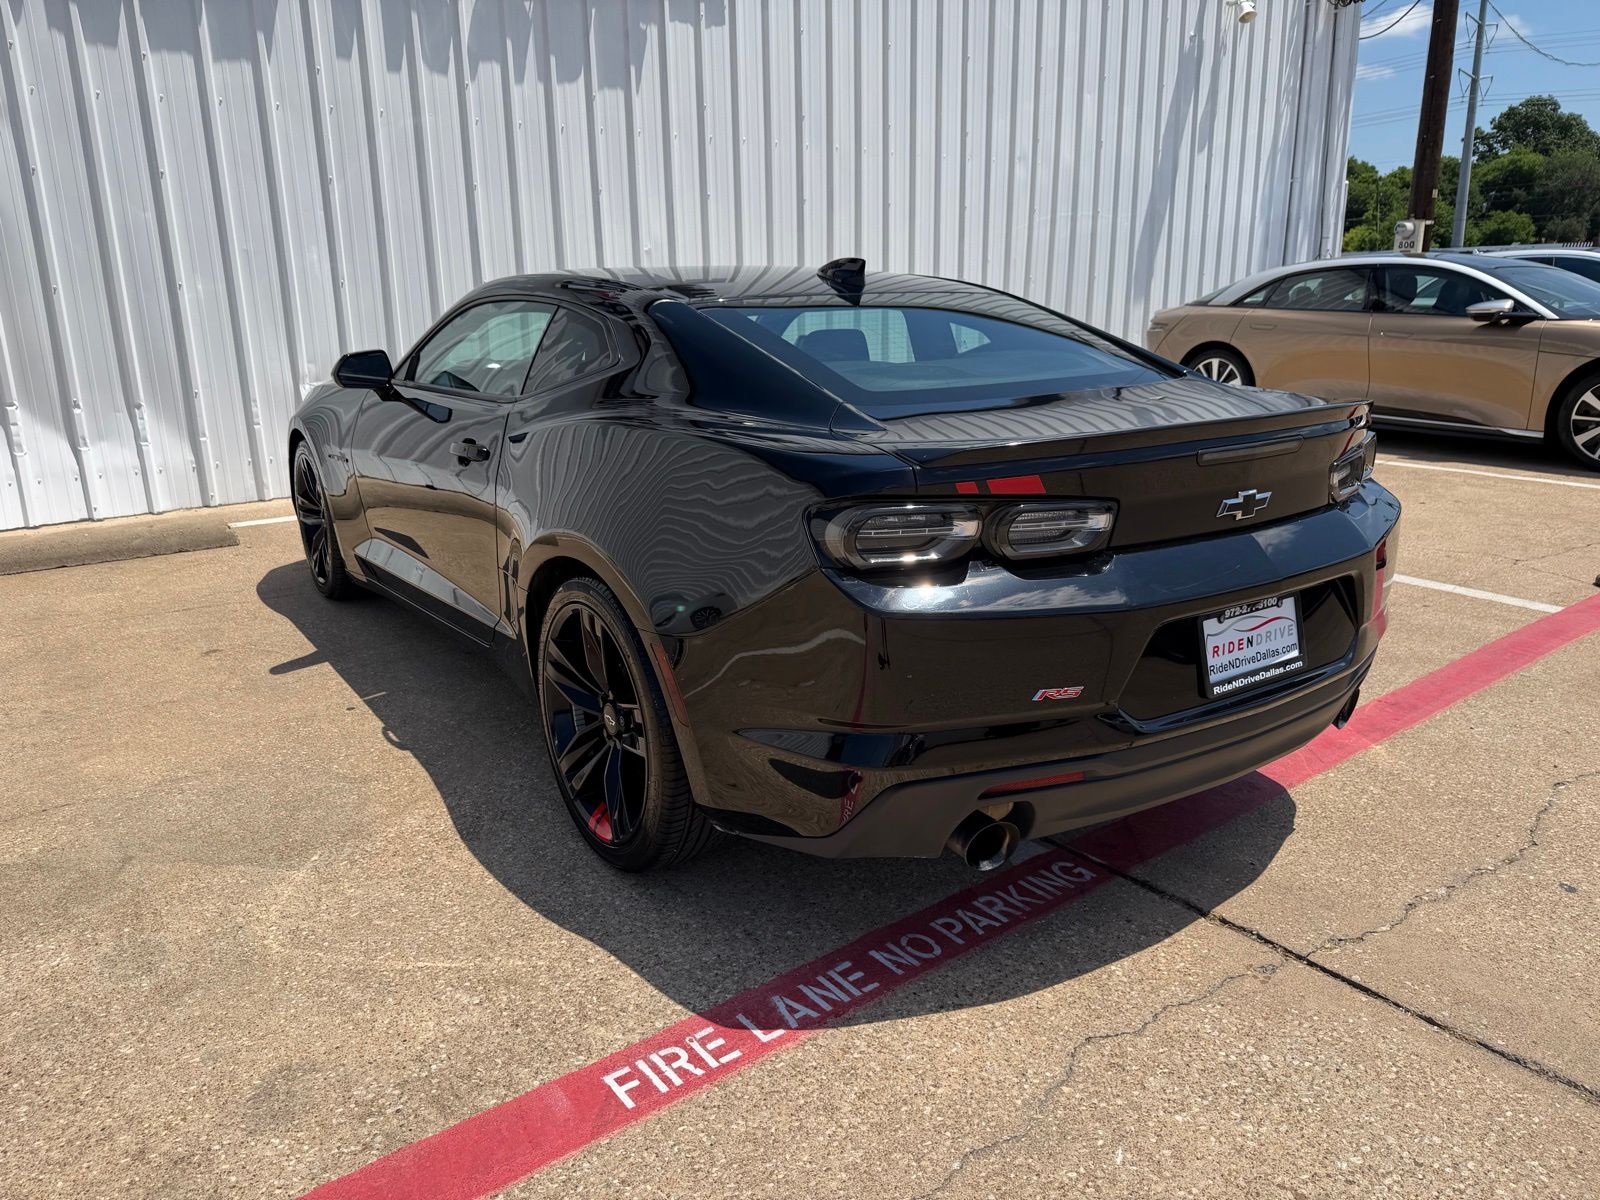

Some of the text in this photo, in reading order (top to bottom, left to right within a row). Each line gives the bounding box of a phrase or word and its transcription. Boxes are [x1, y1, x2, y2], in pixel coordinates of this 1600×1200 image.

[1212, 624, 1294, 658] RIDENDRIVE
[1209, 642, 1298, 676] RideNDriveDallas.com
[1031, 686, 1084, 701] RS
[1213, 661, 1303, 695] RideNDriveDallas.com
[602, 861, 1096, 1109] FIRE LANE NO PARKING
